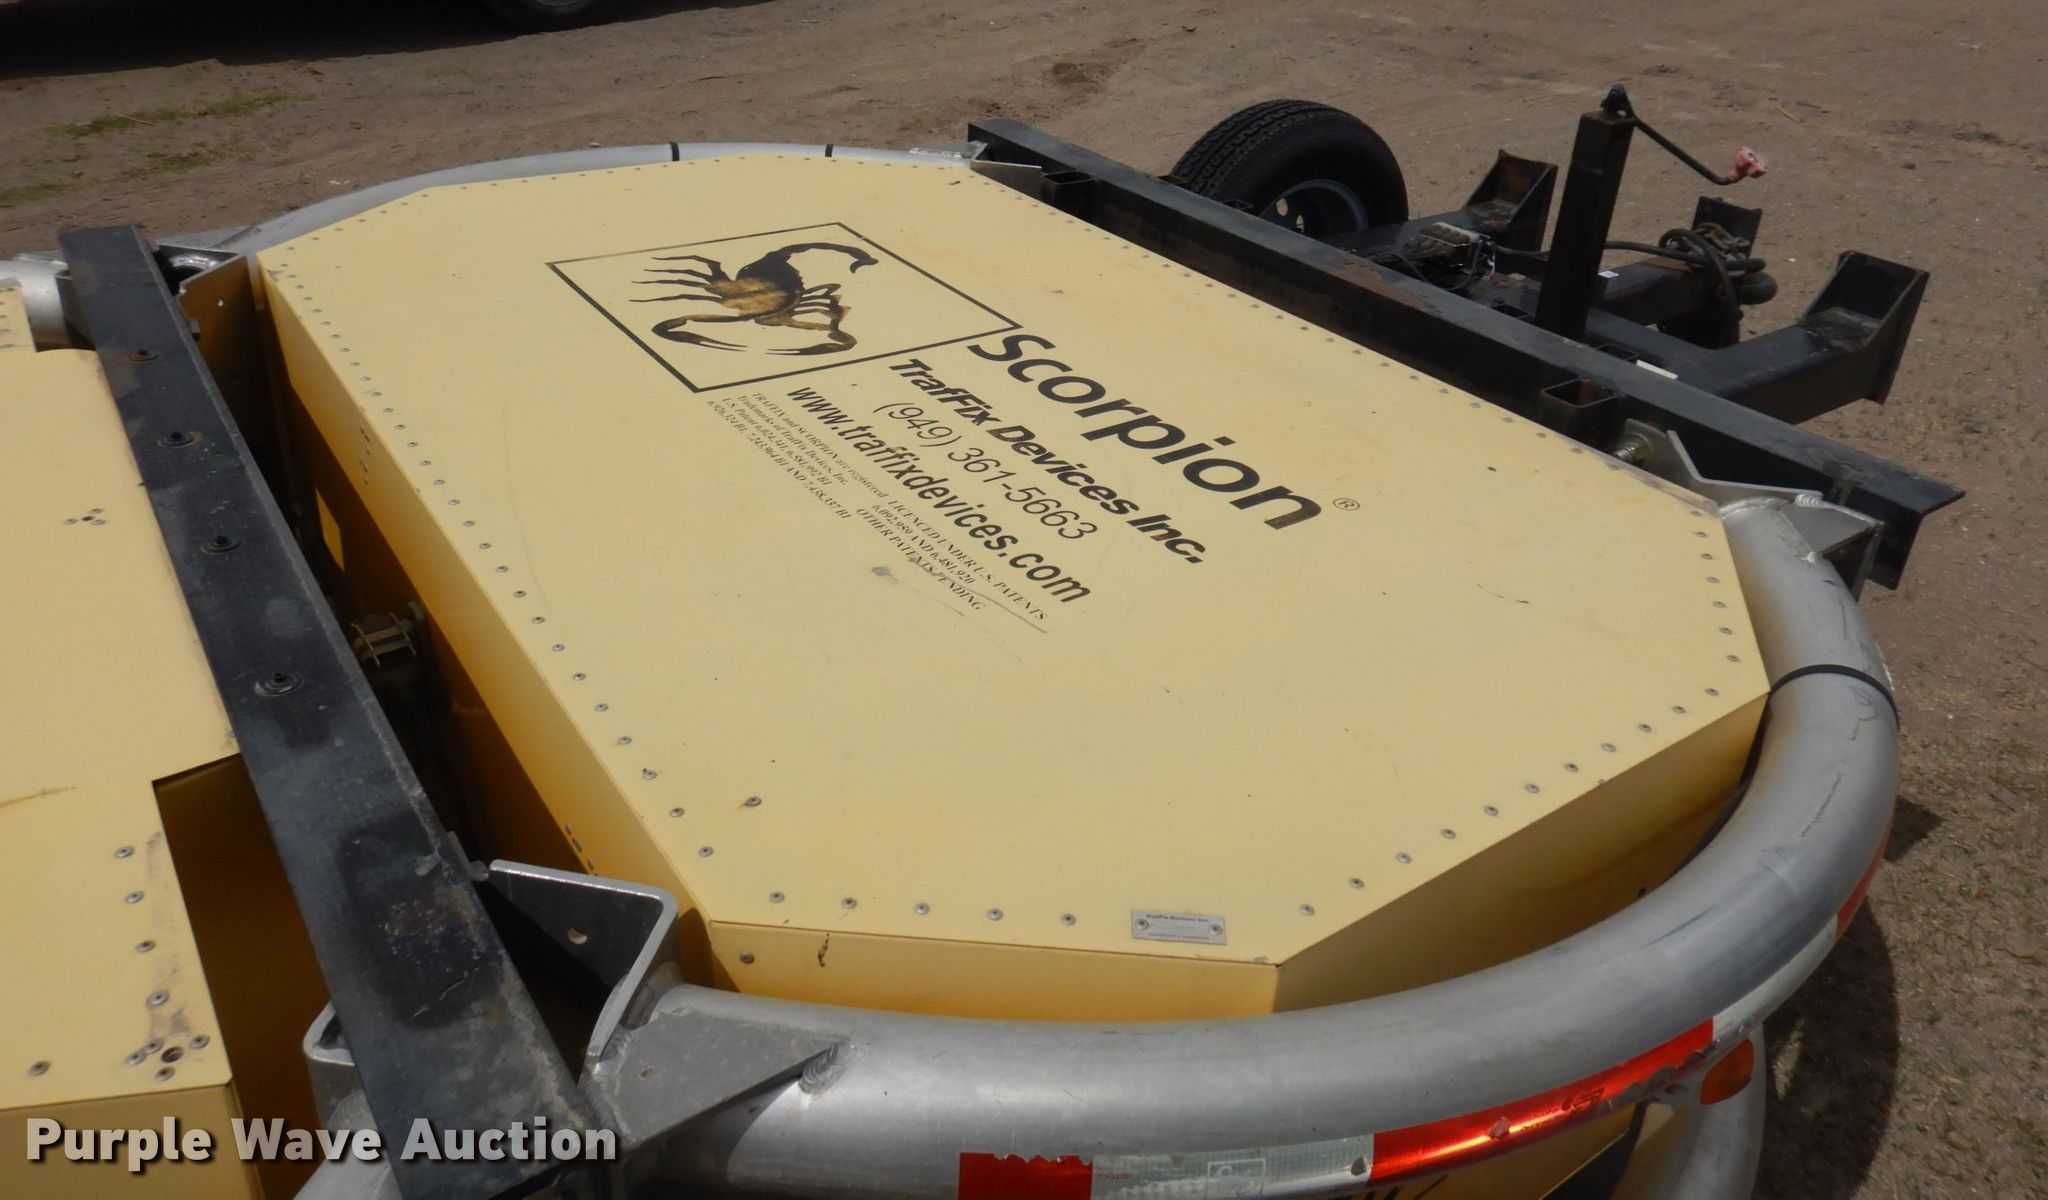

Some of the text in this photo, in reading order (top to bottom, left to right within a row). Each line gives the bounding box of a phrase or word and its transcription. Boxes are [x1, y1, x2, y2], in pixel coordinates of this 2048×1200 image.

[786, 386, 1091, 603] www.traffixdevices.com
[798, 428, 838, 459] SCORPION
[872, 402, 1098, 540] (949) 361-5663
[889, 358, 1206, 564] TrafFix Devices Inc.
[966, 334, 1321, 530] Scorpion
[856, 509, 985, 609] OTHER PATENTS PENDING
[888, 500, 940, 538] LICENCED
[937, 539, 976, 567] UNDER
[993, 582, 1044, 620] PATENTS
[911, 536, 934, 552] AND
